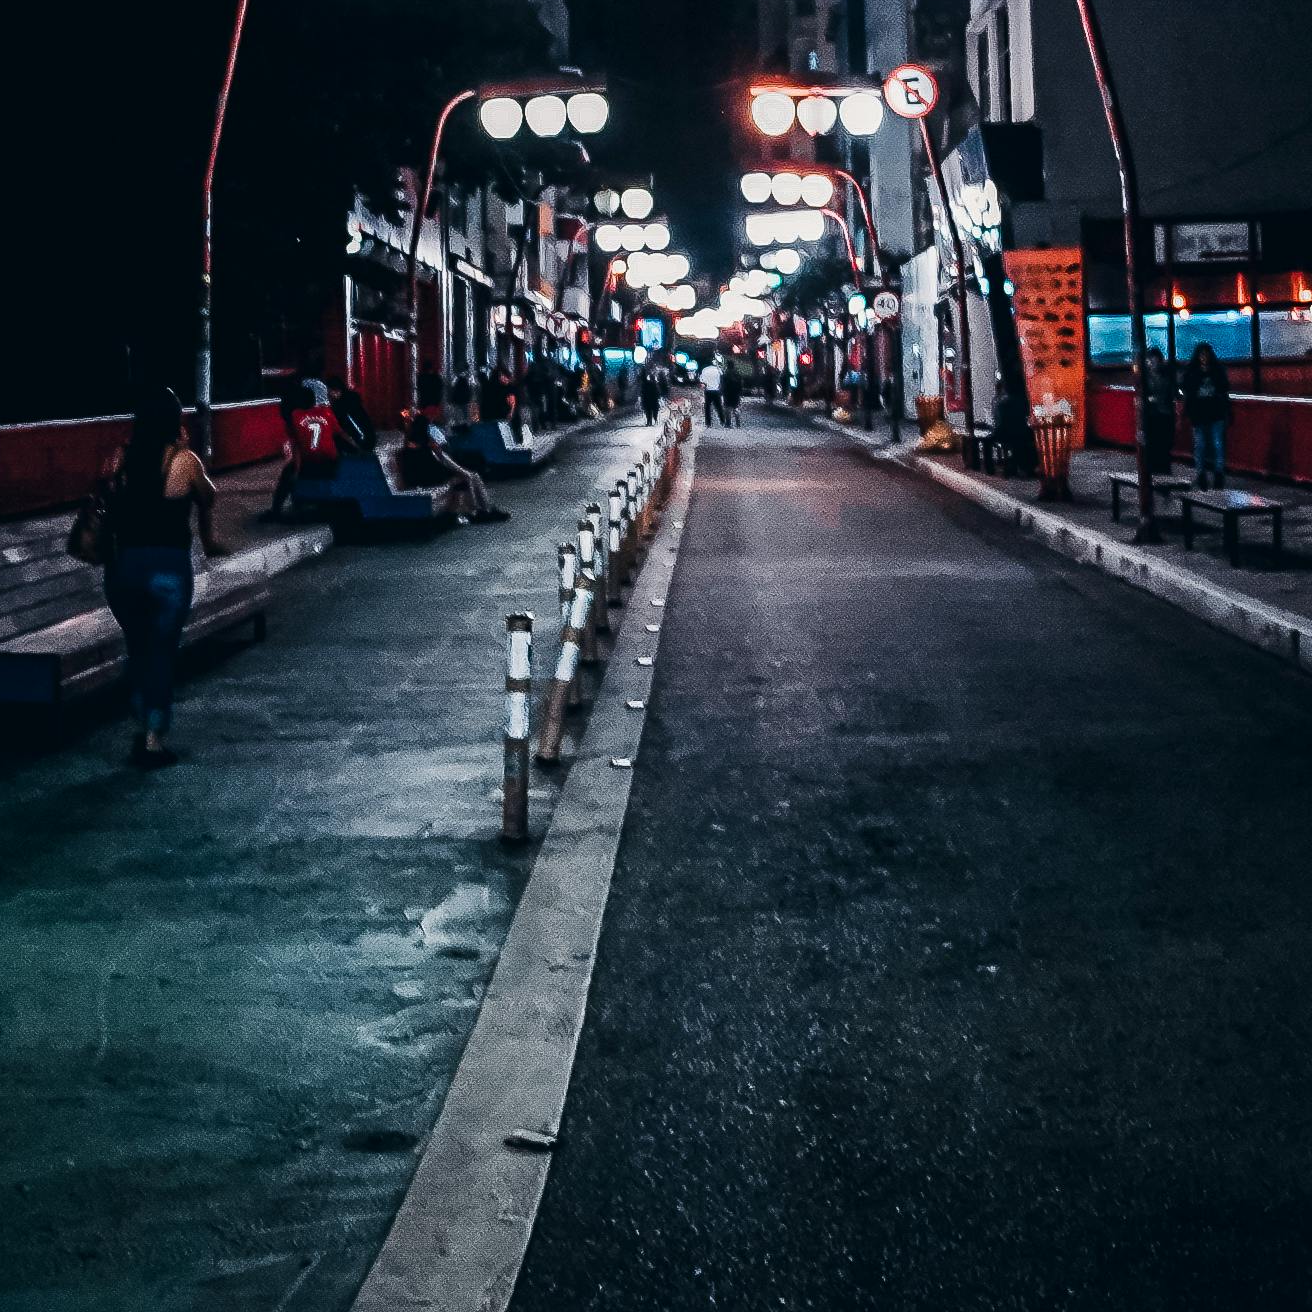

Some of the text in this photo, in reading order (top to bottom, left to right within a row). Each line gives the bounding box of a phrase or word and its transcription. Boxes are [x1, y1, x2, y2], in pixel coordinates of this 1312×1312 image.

[901, 77, 922, 104] E
[877, 298, 896, 312] 40
[308, 423, 321, 450] 7
